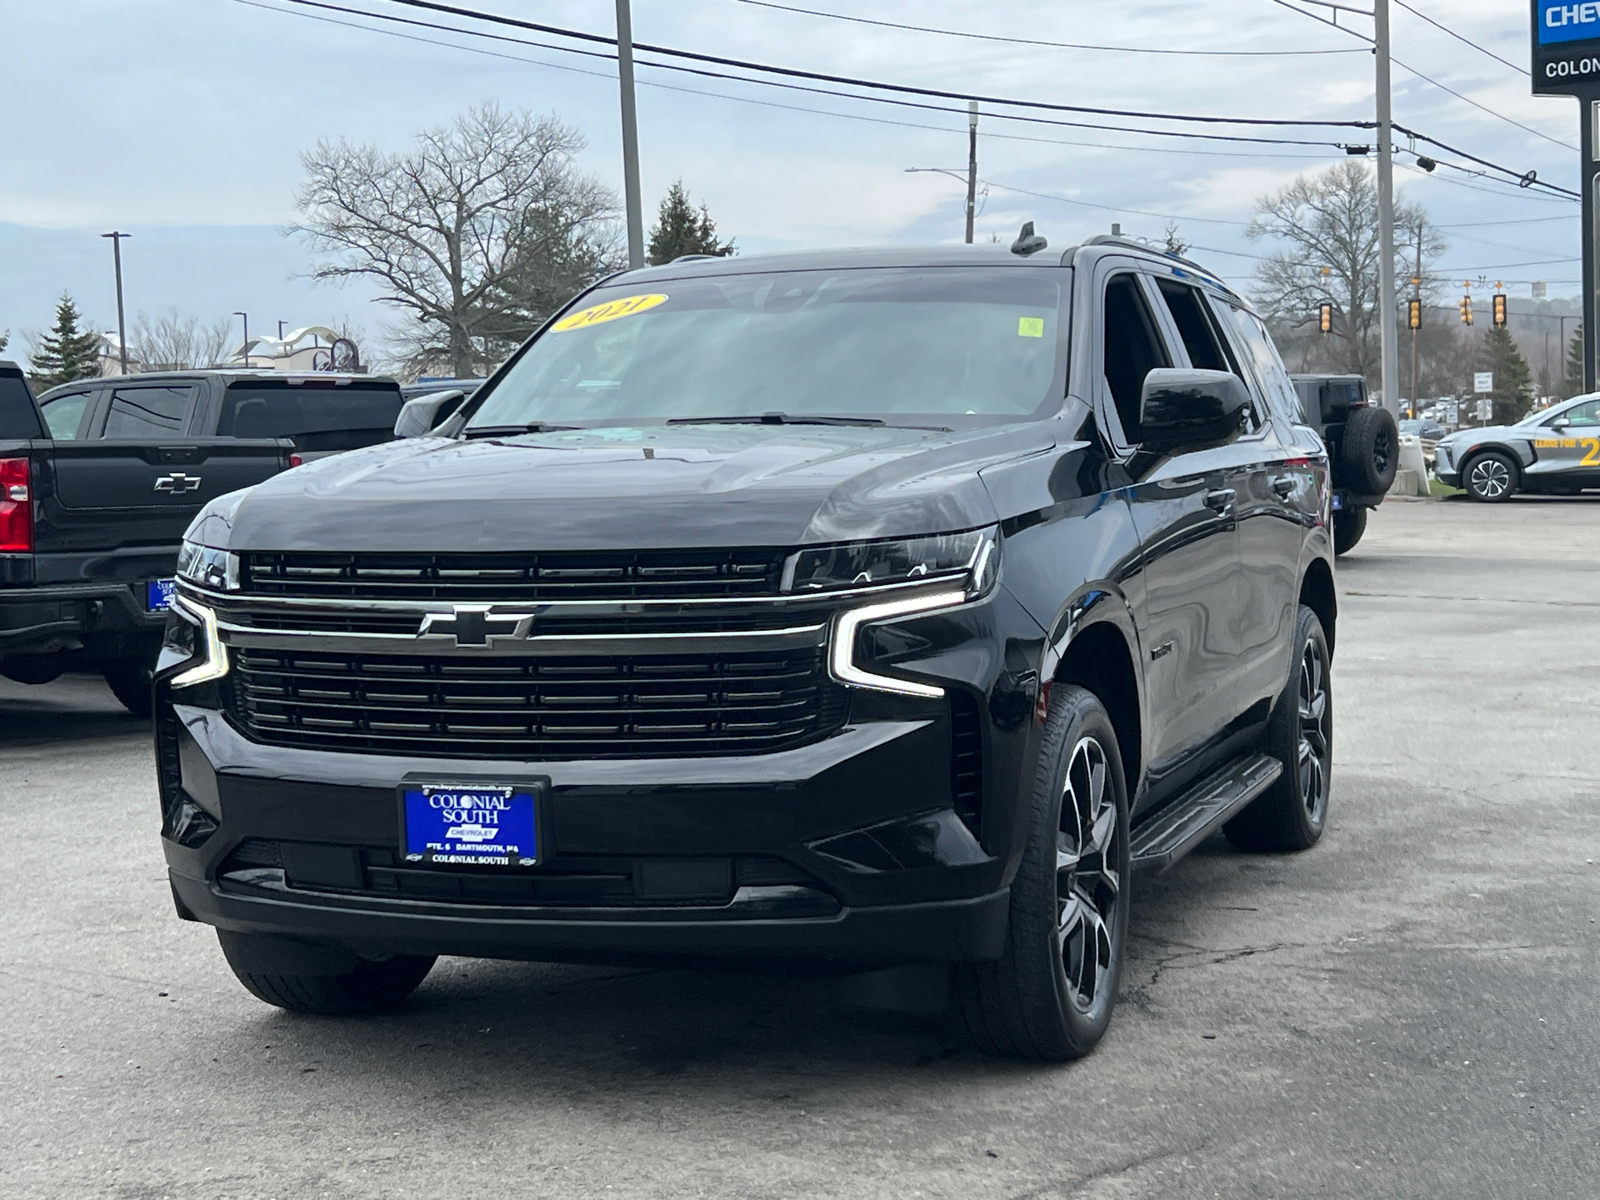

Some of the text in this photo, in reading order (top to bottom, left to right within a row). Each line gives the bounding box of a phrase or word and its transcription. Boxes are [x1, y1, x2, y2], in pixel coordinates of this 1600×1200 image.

[566, 295, 653, 329] 2021
[429, 794, 511, 810] COLONIAL
[443, 809, 499, 824] SOUTH
[450, 829, 493, 837] CHEVROLET
[445, 843, 451, 851] 6
[456, 844, 506, 853] DARTMOUTH,
[432, 854, 509, 865] COLONIAL SOUTH
